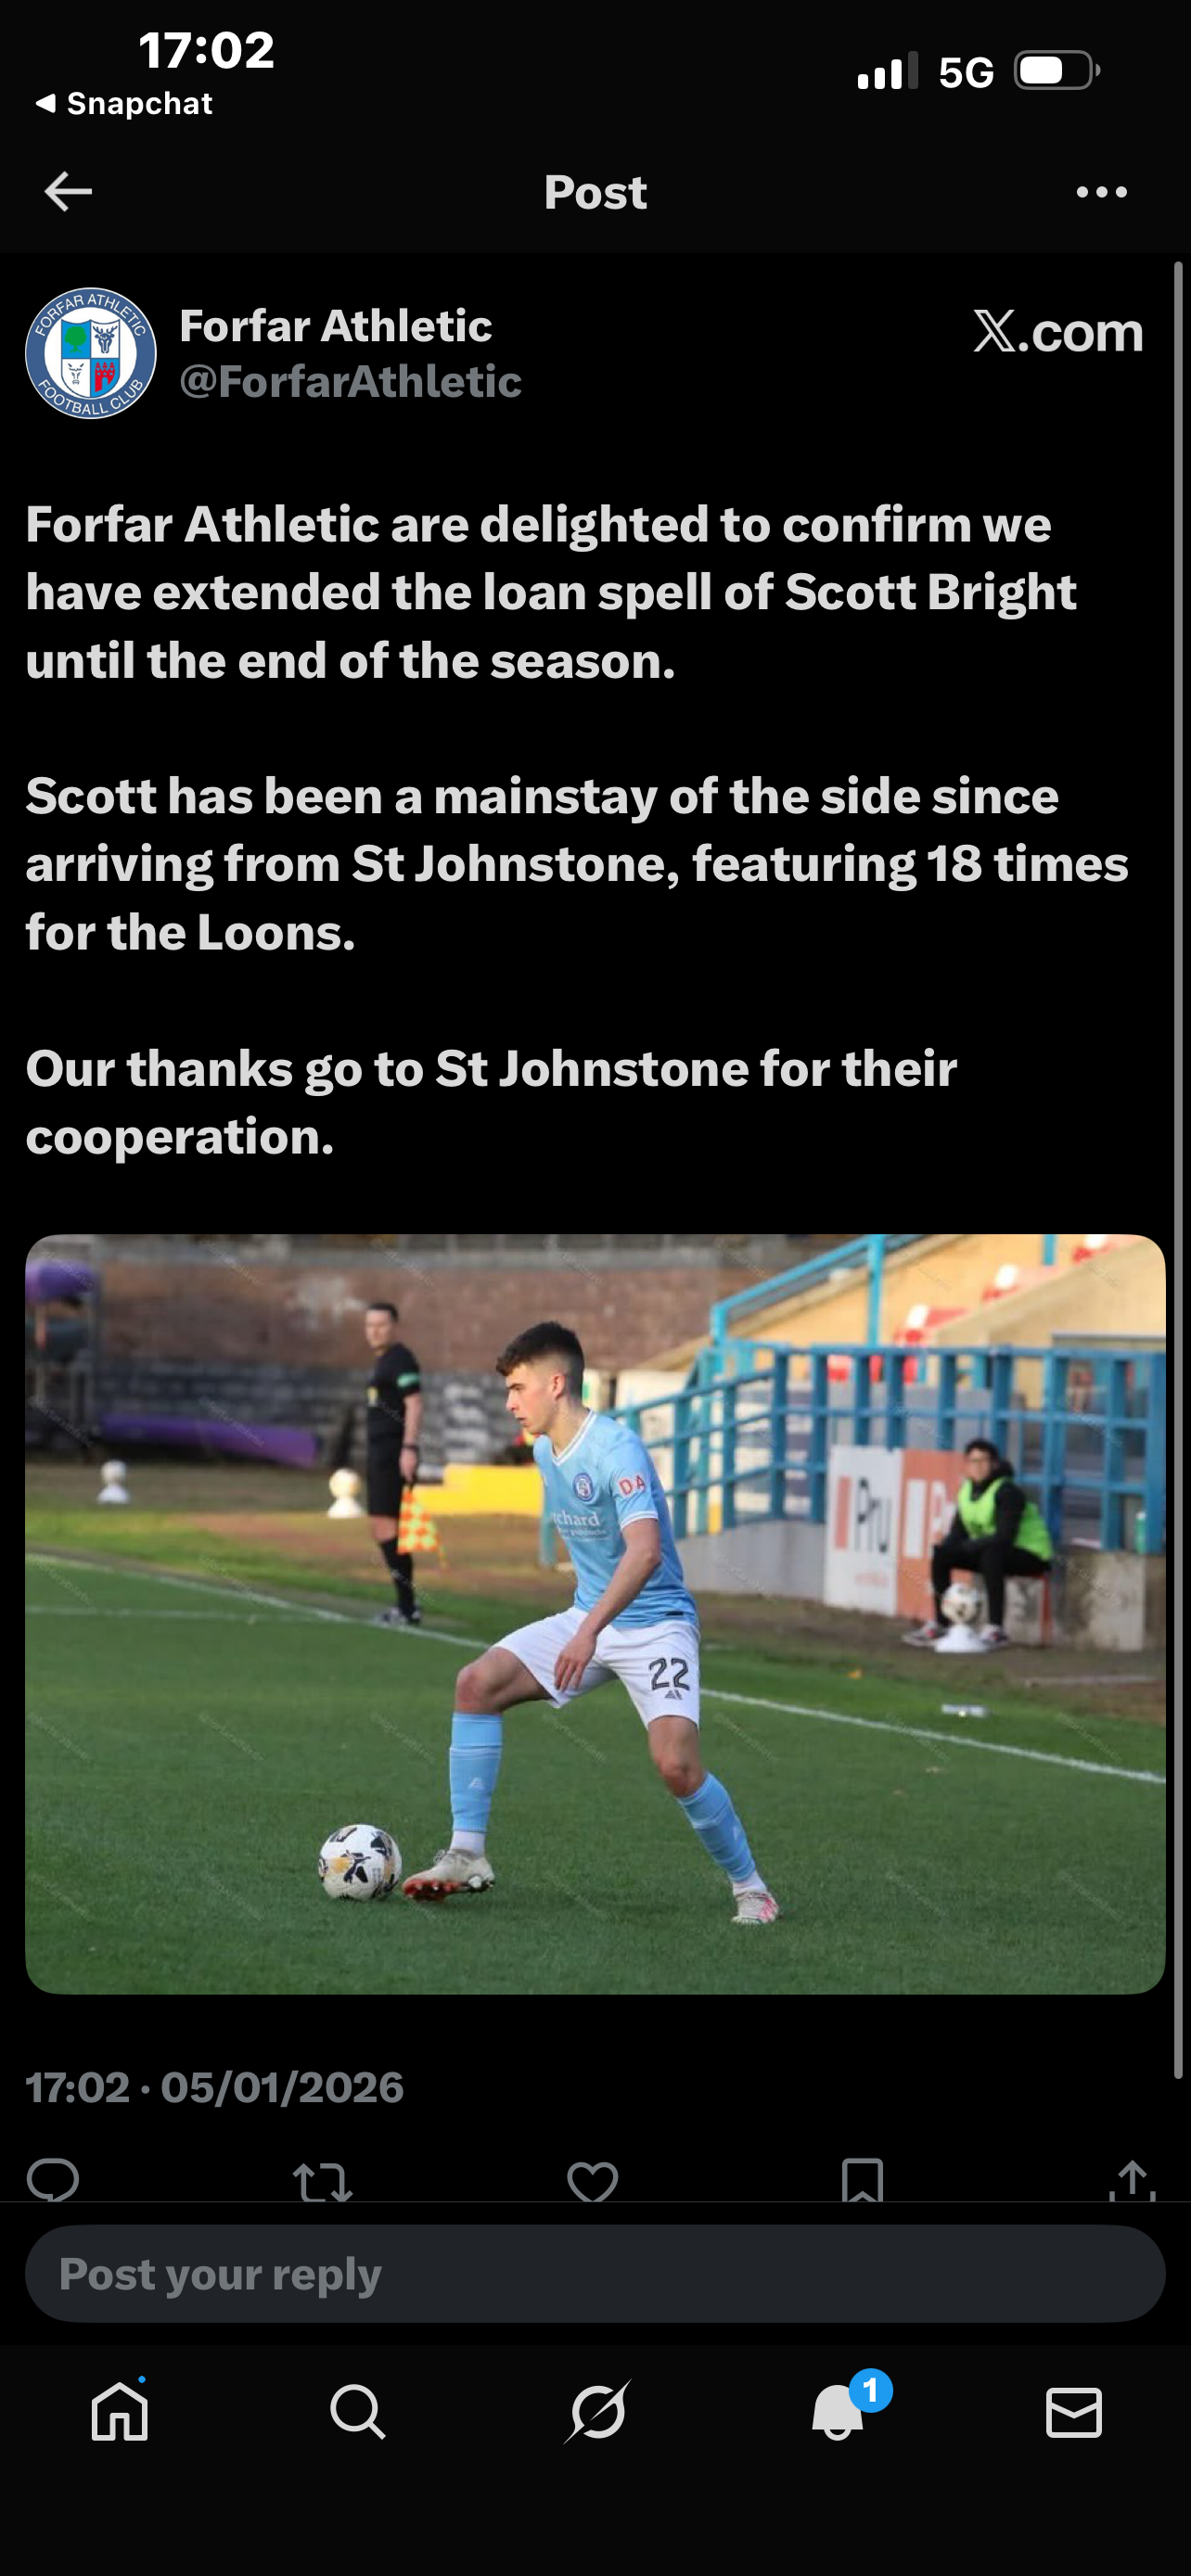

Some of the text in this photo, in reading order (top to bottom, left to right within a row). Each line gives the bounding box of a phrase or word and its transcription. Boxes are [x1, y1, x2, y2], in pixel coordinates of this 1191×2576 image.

[140, 32, 274, 69] 17:02
[941, 57, 993, 88] 5G
[68, 91, 212, 120] Snapchat
[546, 175, 647, 210] Post
[35, 293, 146, 337] FORFAR ATHLETIC
[182, 308, 492, 342] Forfar Athletic
[38, 378, 143, 414] FOOTBALL CLUB
[181, 363, 521, 398] @ForfarAthletic
[28, 504, 1051, 552] Forfar Athletic are delighted to confirm we
[28, 571, 1076, 619] have extended the loan spell of Scott Bright
[28, 640, 673, 679] until the end of the season.
[26, 775, 1058, 823] Scott has been a mainstay of the side since
[26, 843, 1128, 891] arriving from St Johnstone, featuring 18 times
[26, 912, 353, 950] for the Loons.
[27, 1048, 957, 1096] Our thanks go to St Johnstone for their
[27, 1116, 332, 1164] cooperation.
[647, 1657, 690, 1690] 22
[26, 2071, 403, 2107] 17:02 05/01/2026
[61, 2256, 382, 2299] Post your reply
[864, 2378, 876, 2402] 1
